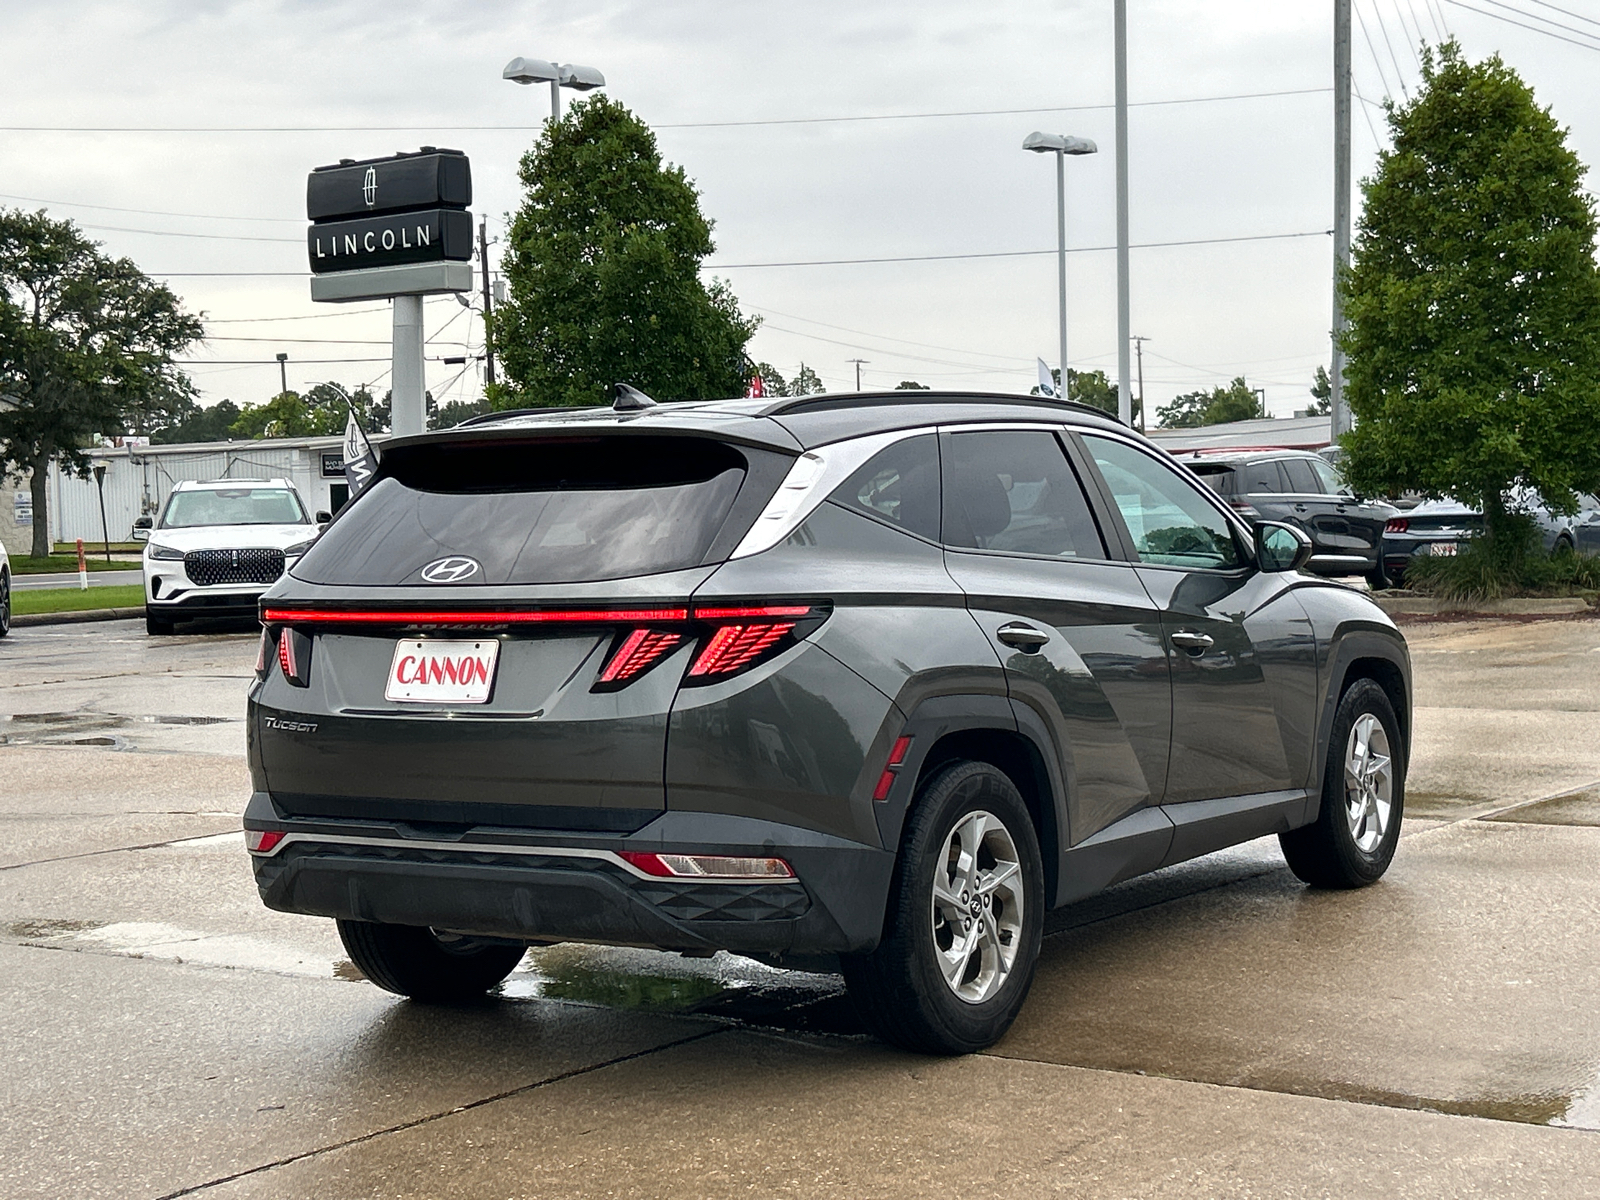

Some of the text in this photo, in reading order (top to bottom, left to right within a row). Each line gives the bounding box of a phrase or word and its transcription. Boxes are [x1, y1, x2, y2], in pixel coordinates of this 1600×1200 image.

[316, 225, 430, 258] LINCOLN
[396, 656, 491, 685] CANNON
[264, 716, 318, 733] TUCSON
